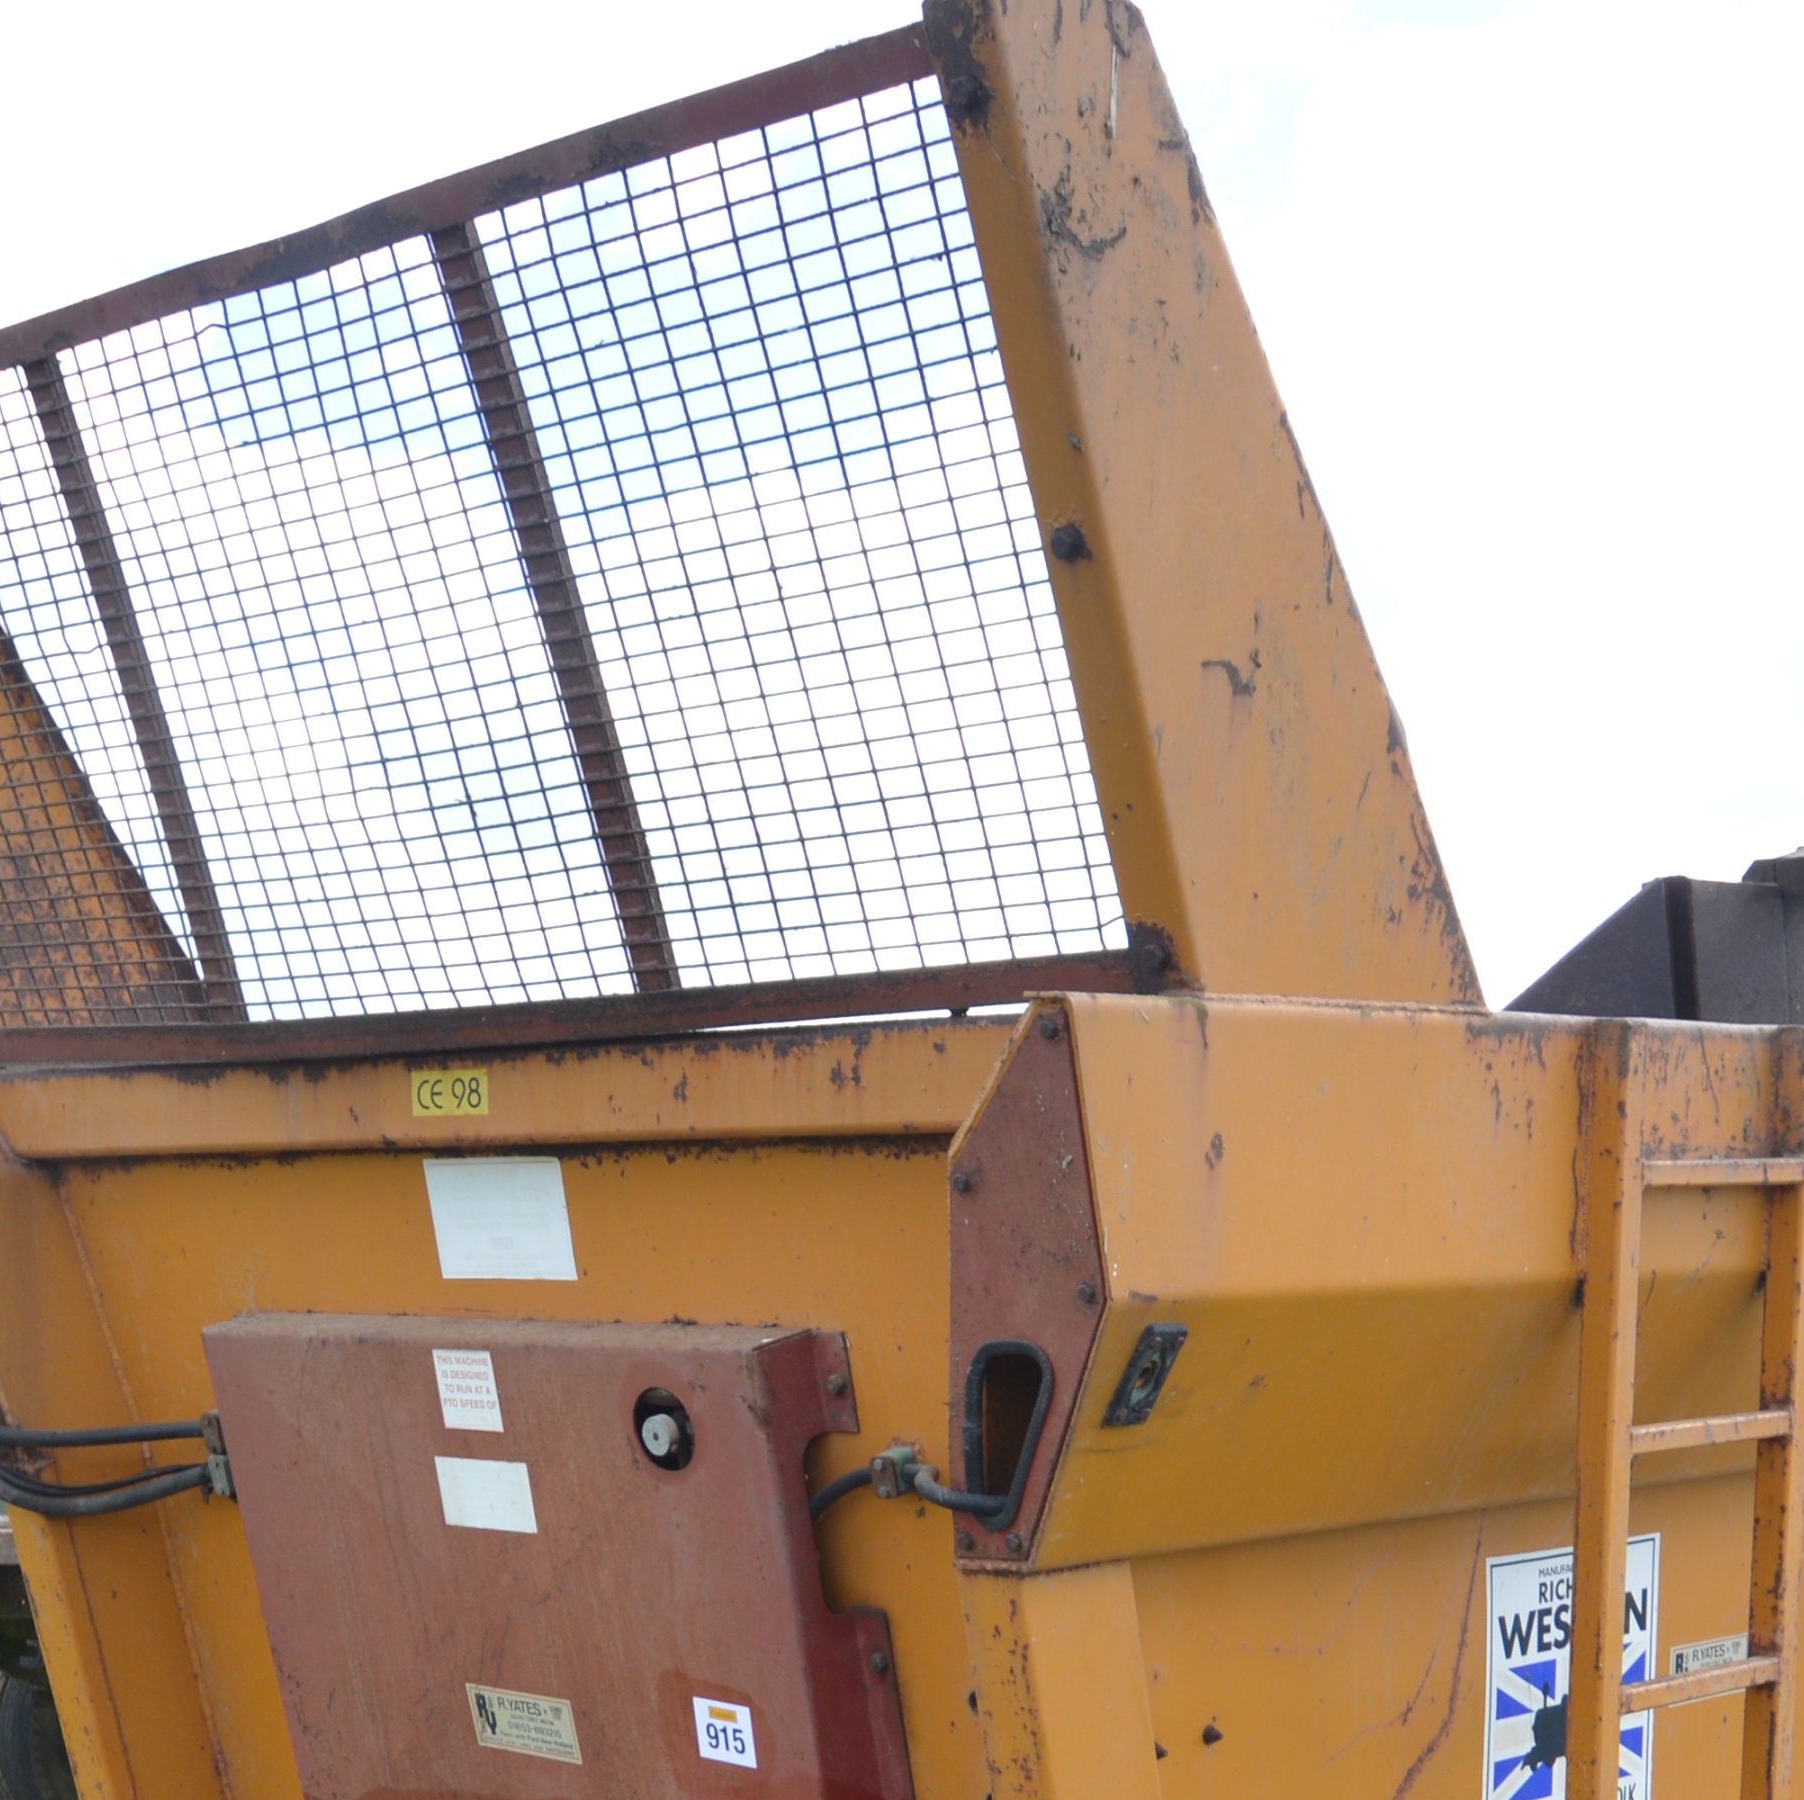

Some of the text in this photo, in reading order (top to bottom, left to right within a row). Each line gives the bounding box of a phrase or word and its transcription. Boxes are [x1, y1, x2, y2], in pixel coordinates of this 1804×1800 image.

[416, 1076, 482, 1110] CE 98
[437, 1356, 489, 1367] THIS MACHINE
[442, 1370, 488, 1380] IS DESIGNED
[444, 1384, 455, 1393] TO
[456, 1385, 472, 1393] RUN
[475, 1386, 483, 1394] AT
[443, 1398, 497, 1409] PTO SPEED OF
[1538, 1579, 1573, 1605] RICH
[1498, 1587, 1648, 1660] WESN
[706, 1722, 745, 1755] 915
